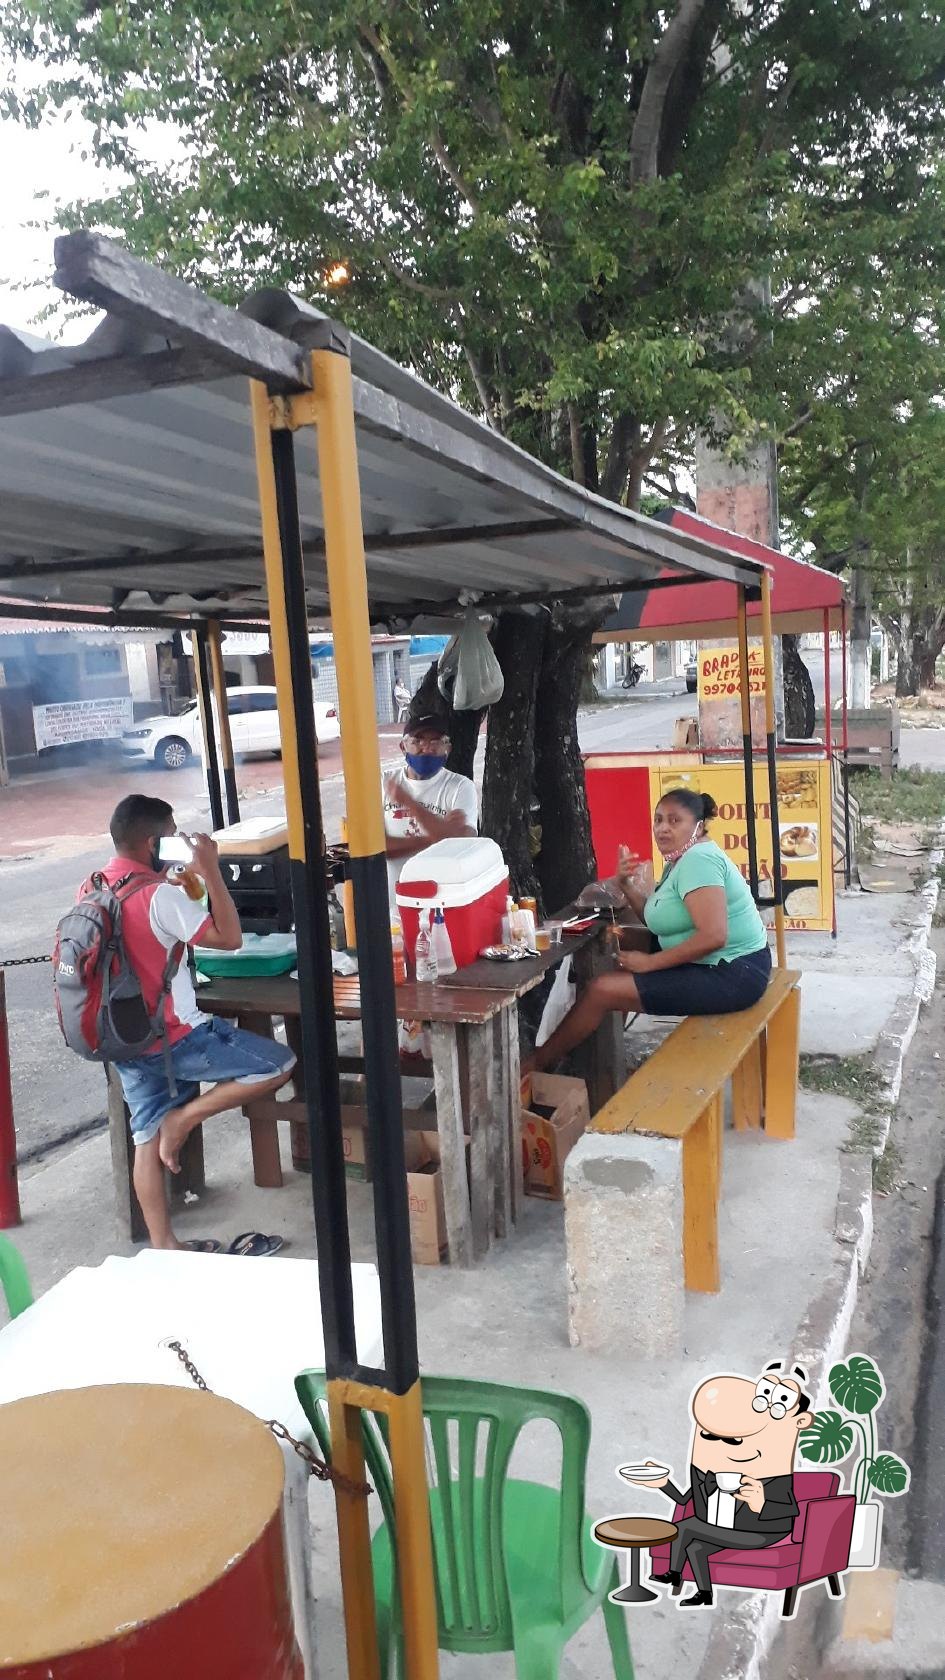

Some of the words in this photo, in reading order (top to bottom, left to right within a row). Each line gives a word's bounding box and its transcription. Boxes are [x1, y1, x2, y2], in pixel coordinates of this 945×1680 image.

[703, 651, 760, 677] BRADK
[717, 667, 766, 682] LETRIRO
[384, 801, 447, 816] chuuinho
